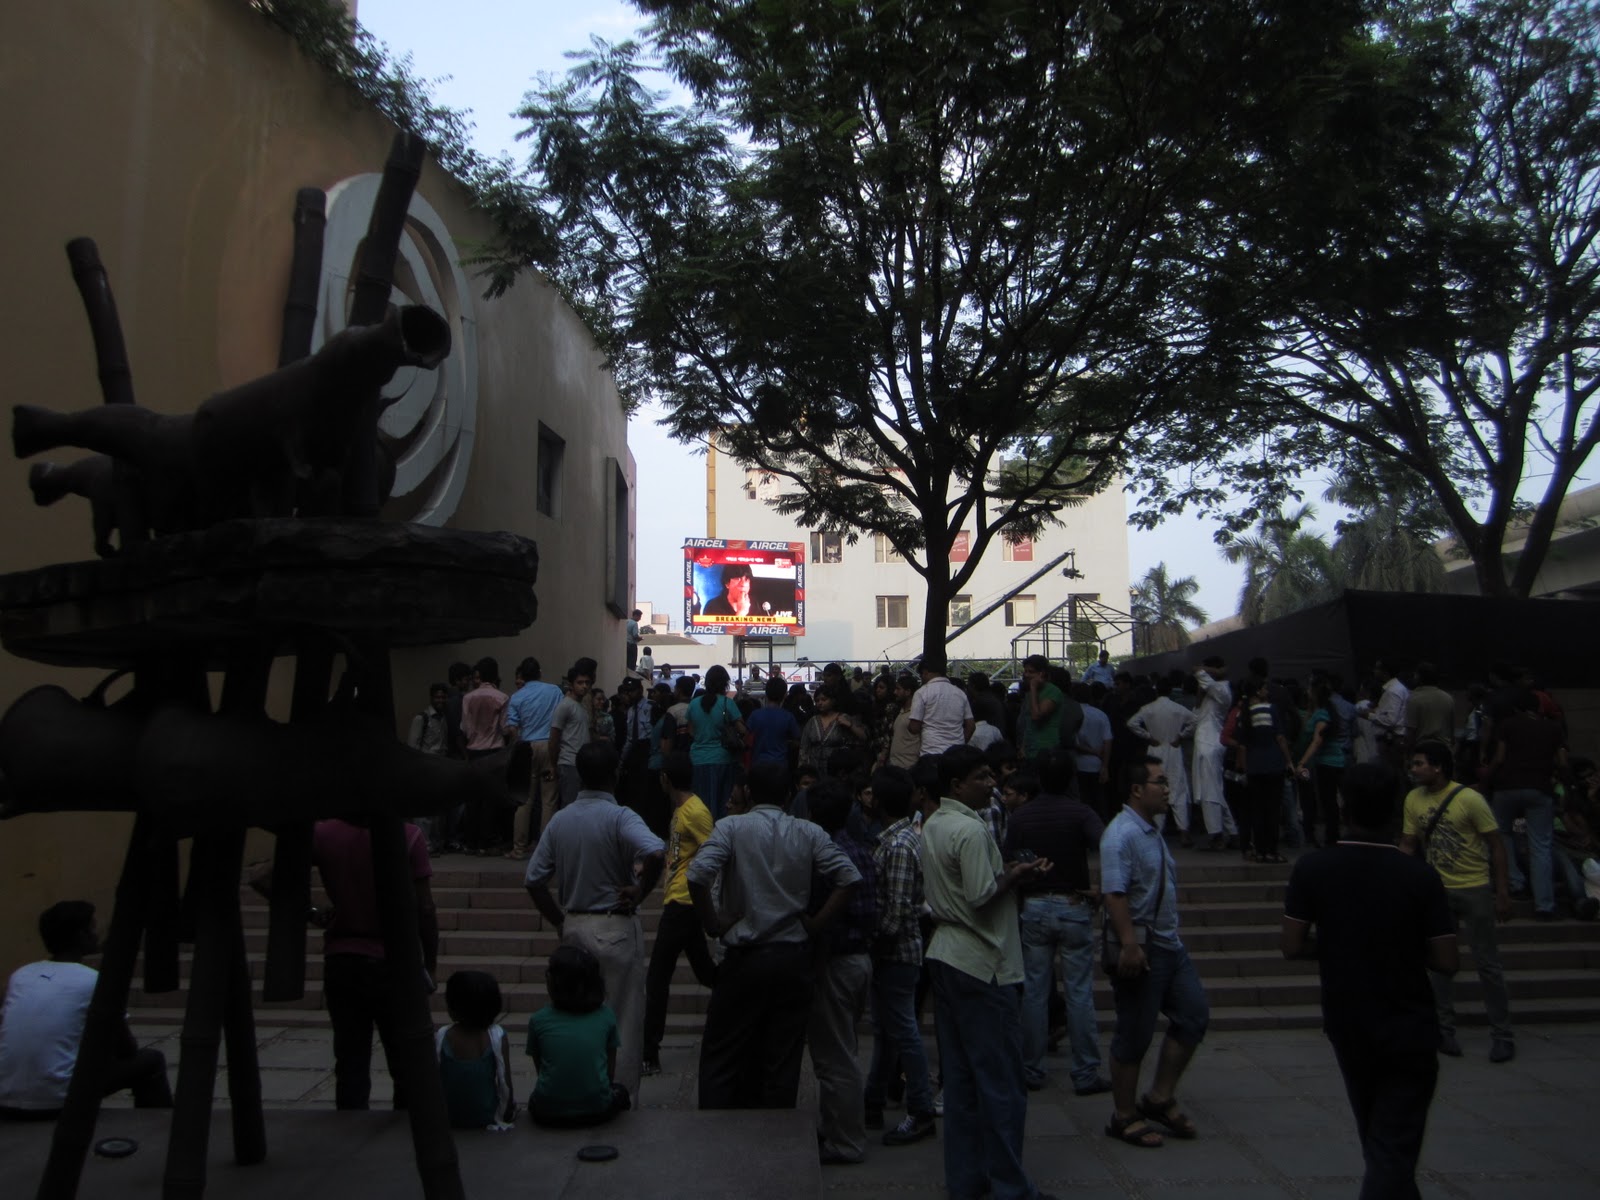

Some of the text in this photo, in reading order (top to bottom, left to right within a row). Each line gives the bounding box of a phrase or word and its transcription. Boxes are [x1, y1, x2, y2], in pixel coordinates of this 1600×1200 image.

[685, 539, 725, 548] AIRCEL
[750, 542, 788, 550] AIRCEL
[684, 626, 724, 634] AIRCEL
[749, 627, 789, 635] AIRCEL
